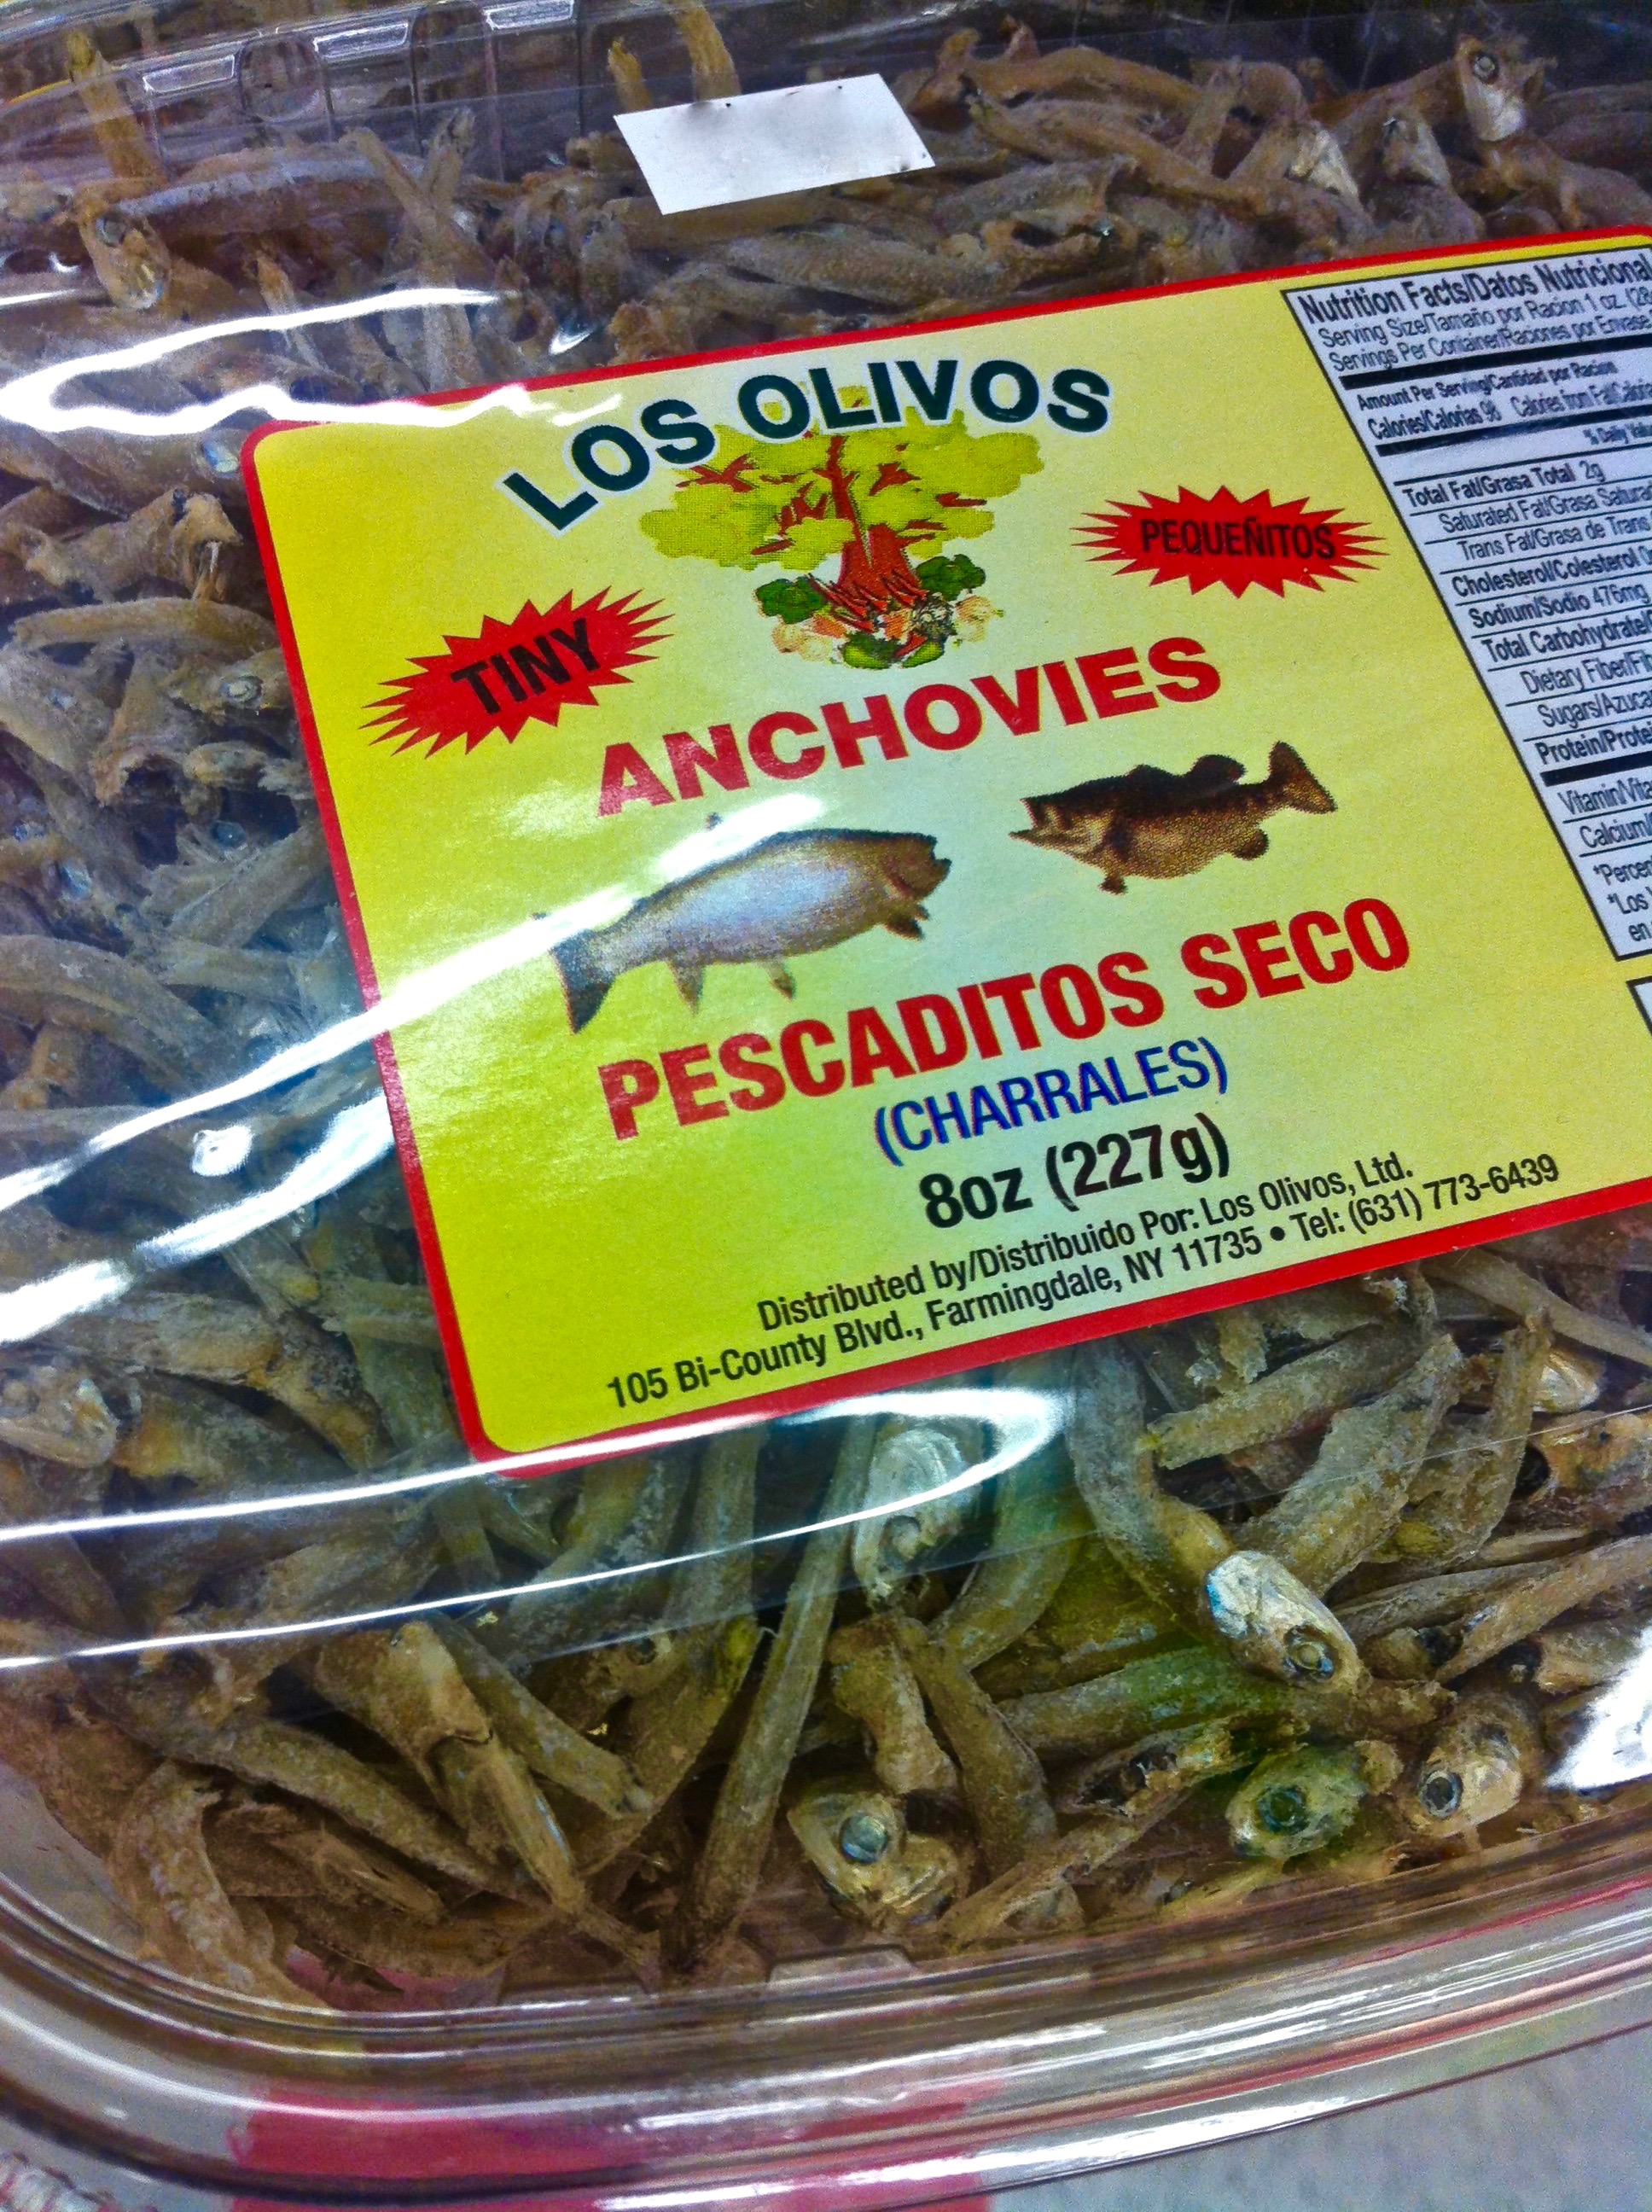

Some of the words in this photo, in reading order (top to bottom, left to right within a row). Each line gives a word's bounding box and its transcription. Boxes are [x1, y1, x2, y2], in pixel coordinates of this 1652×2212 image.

[1298, 288, 1406, 324] Nutrition
[1400, 271, 1539, 310] Facts/Datos
[1318, 323, 1389, 348] Serving
[1386, 307, 1496, 338] Size/Tamaño
[1497, 306, 1525, 324] por
[1585, 293, 1598, 311] 1
[1625, 286, 1652, 311] (28
[1329, 348, 1399, 373] Servings
[1397, 341, 1428, 363] Per
[1428, 324, 1572, 357] Container/Raciones
[1571, 321, 1597, 342] por
[1357, 387, 1413, 411] Amount
[1410, 385, 1436, 403] Per
[1435, 368, 1549, 398] Serving/Cantidad
[1510, 392, 1566, 417] Calories
[503, 399, 715, 531] LOS
[738, 359, 1110, 439] OLIVOS
[1367, 405, 1484, 440] Calories/Calorias
[1402, 483, 1450, 508] Total
[1449, 474, 1535, 500] Fat/Grasa
[1530, 462, 1577, 487] Total
[1579, 459, 1607, 484] 2g
[1140, 516, 1337, 561] PEQUEÑITOS
[1439, 502, 1520, 533] Saturated
[1517, 492, 1600, 521] Fat/Grasa
[1457, 538, 1505, 562] Trans
[1504, 526, 1585, 554] Fat/Grasa
[1585, 520, 1607, 541] de
[1604, 513, 1650, 537] Trans
[1451, 546, 1641, 598] Cholesterol/Colesterol
[1468, 591, 1591, 629] Sodium/Sodio
[1591, 583, 1651, 607] 476mg
[451, 617, 600, 716] TINY
[1480, 633, 1531, 662] Total
[1519, 667, 1585, 696] Dietary
[597, 637, 1221, 818] ANCHOVIES
[1628, 922, 1651, 942] en
[596, 952, 1166, 1141] PESCADITOS
[1181, 898, 1411, 1010] SECO
[875, 1036, 1229, 1167] (CHARRALES)
[918, 1165, 1033, 1228] 8oz
[1045, 1112, 1230, 1211] (227g)
[757, 1264, 926, 1331] Distributed
[931, 1217, 1136, 1291] by/Distribuido
[1140, 1208, 1200, 1246] Por:
[1200, 1191, 1254, 1226] Los
[1259, 1170, 1357, 1212] Olivos,
[1353, 1150, 1415, 1189] Ltd.
[607, 1365, 669, 1408] 105
[674, 1332, 827, 1393] Bi-County
[836, 1311, 925, 1354] Blvd.,
[926, 1264, 1122, 1331] Farmingdale,
[1122, 1247, 1165, 1285] NY
[1172, 1225, 1263, 1273] 11735
[1289, 1208, 1346, 1243] Tel:
[1348, 1185, 1422, 1235] (631)
[1422, 1152, 1561, 1211] 773-6439
